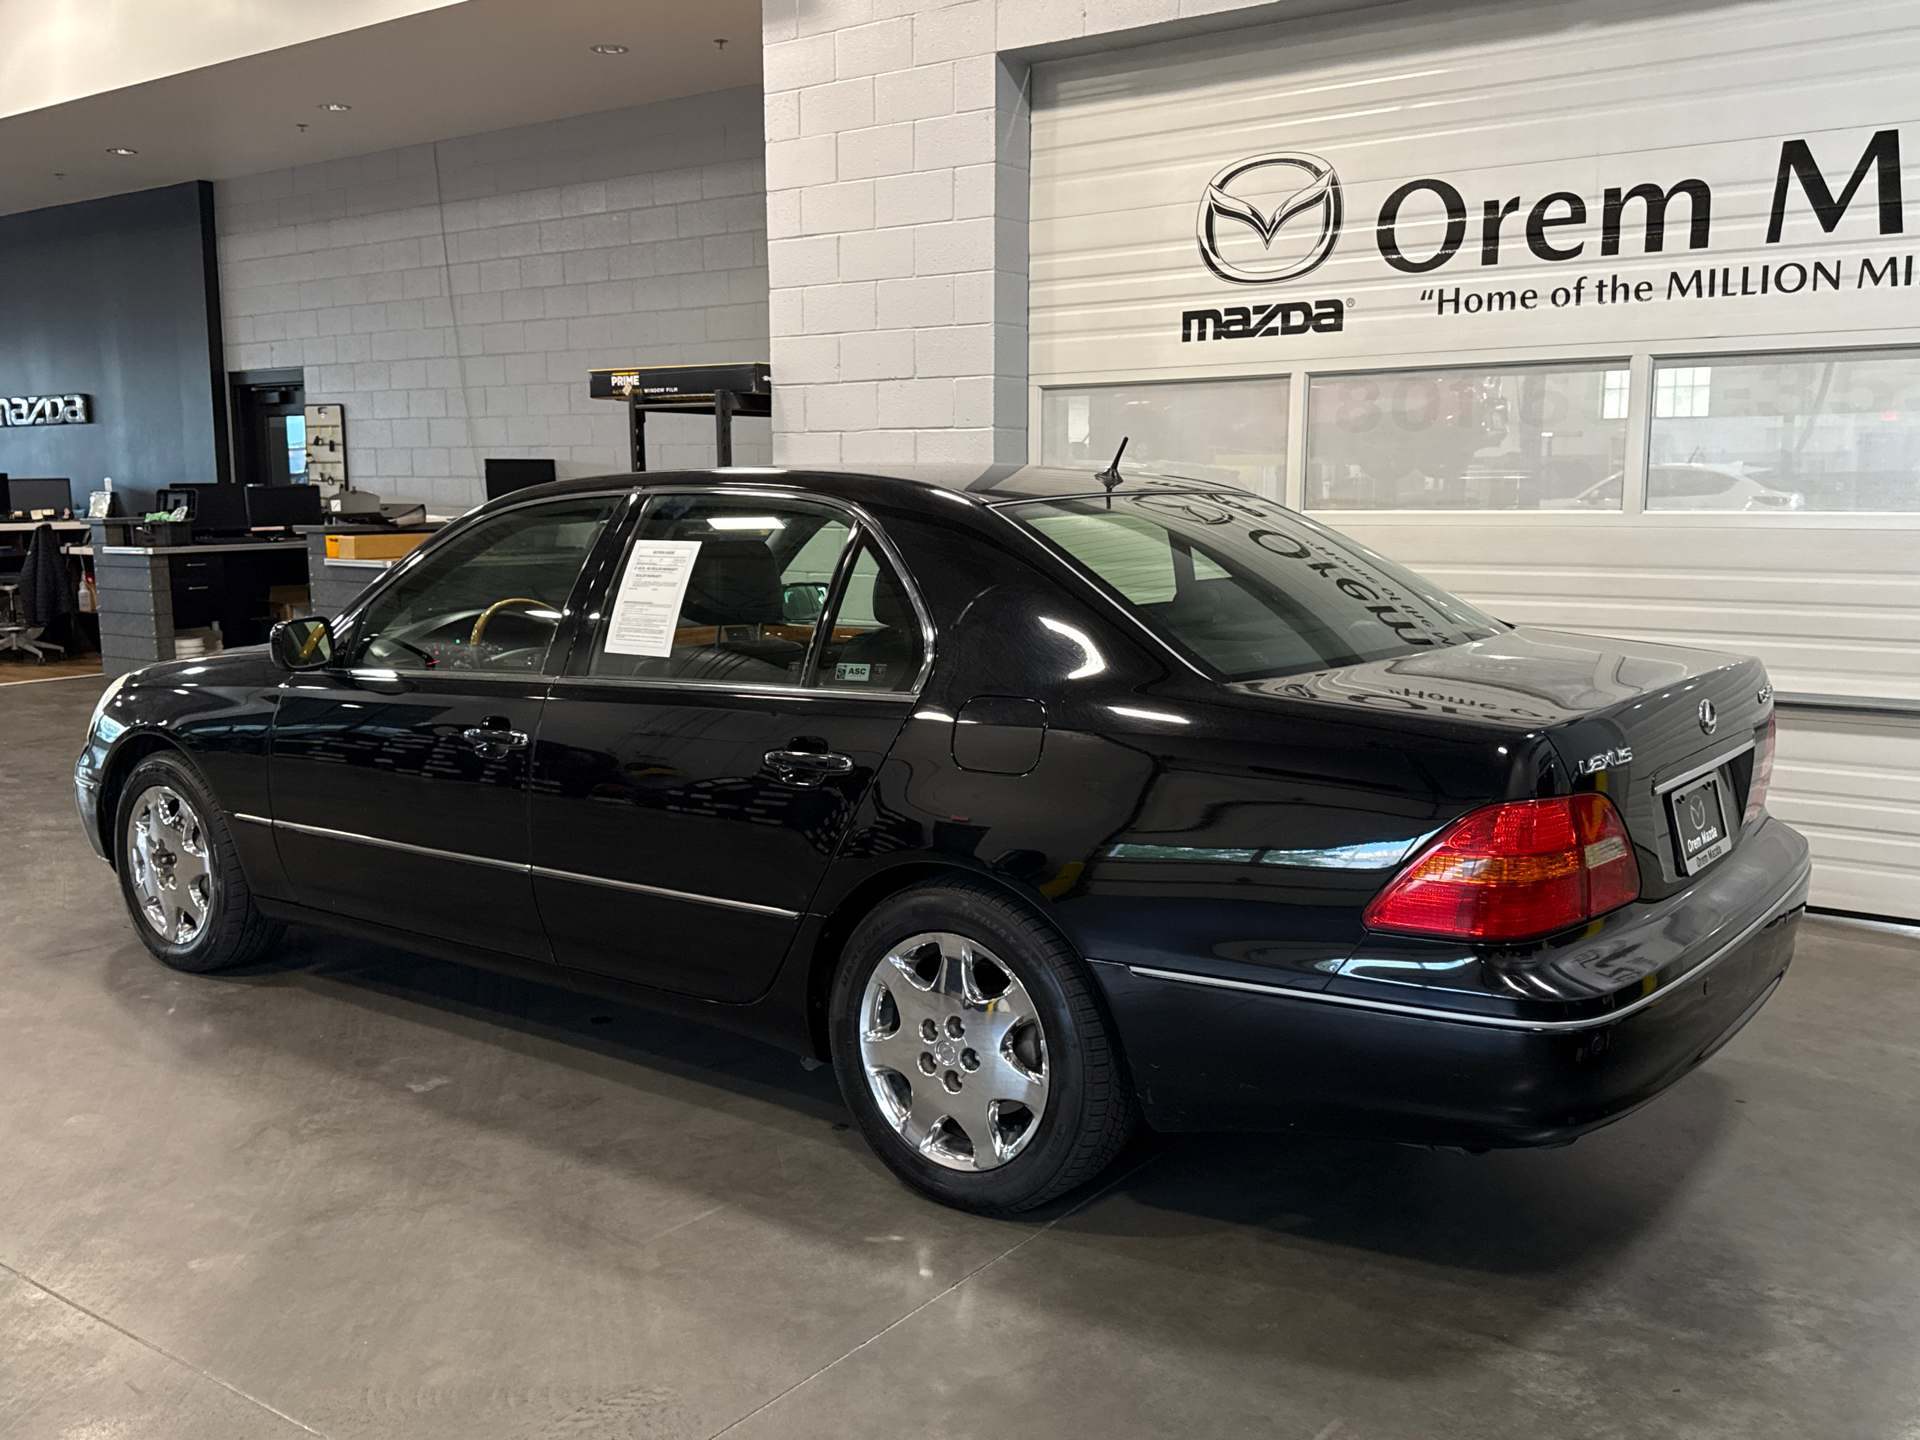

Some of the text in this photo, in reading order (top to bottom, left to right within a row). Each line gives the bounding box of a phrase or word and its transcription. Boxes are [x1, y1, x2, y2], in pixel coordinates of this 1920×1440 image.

[1377, 178, 1711, 273] Orem
[1550, 276, 1588, 307] of
[1595, 274, 1653, 304] the
[1667, 260, 1842, 300] MILLION
[1857, 255, 1920, 289] MI
[611, 375, 640, 386] PRIME
[1578, 747, 1633, 775] LEXUS
[1687, 825, 1718, 853] Orem Mazda
